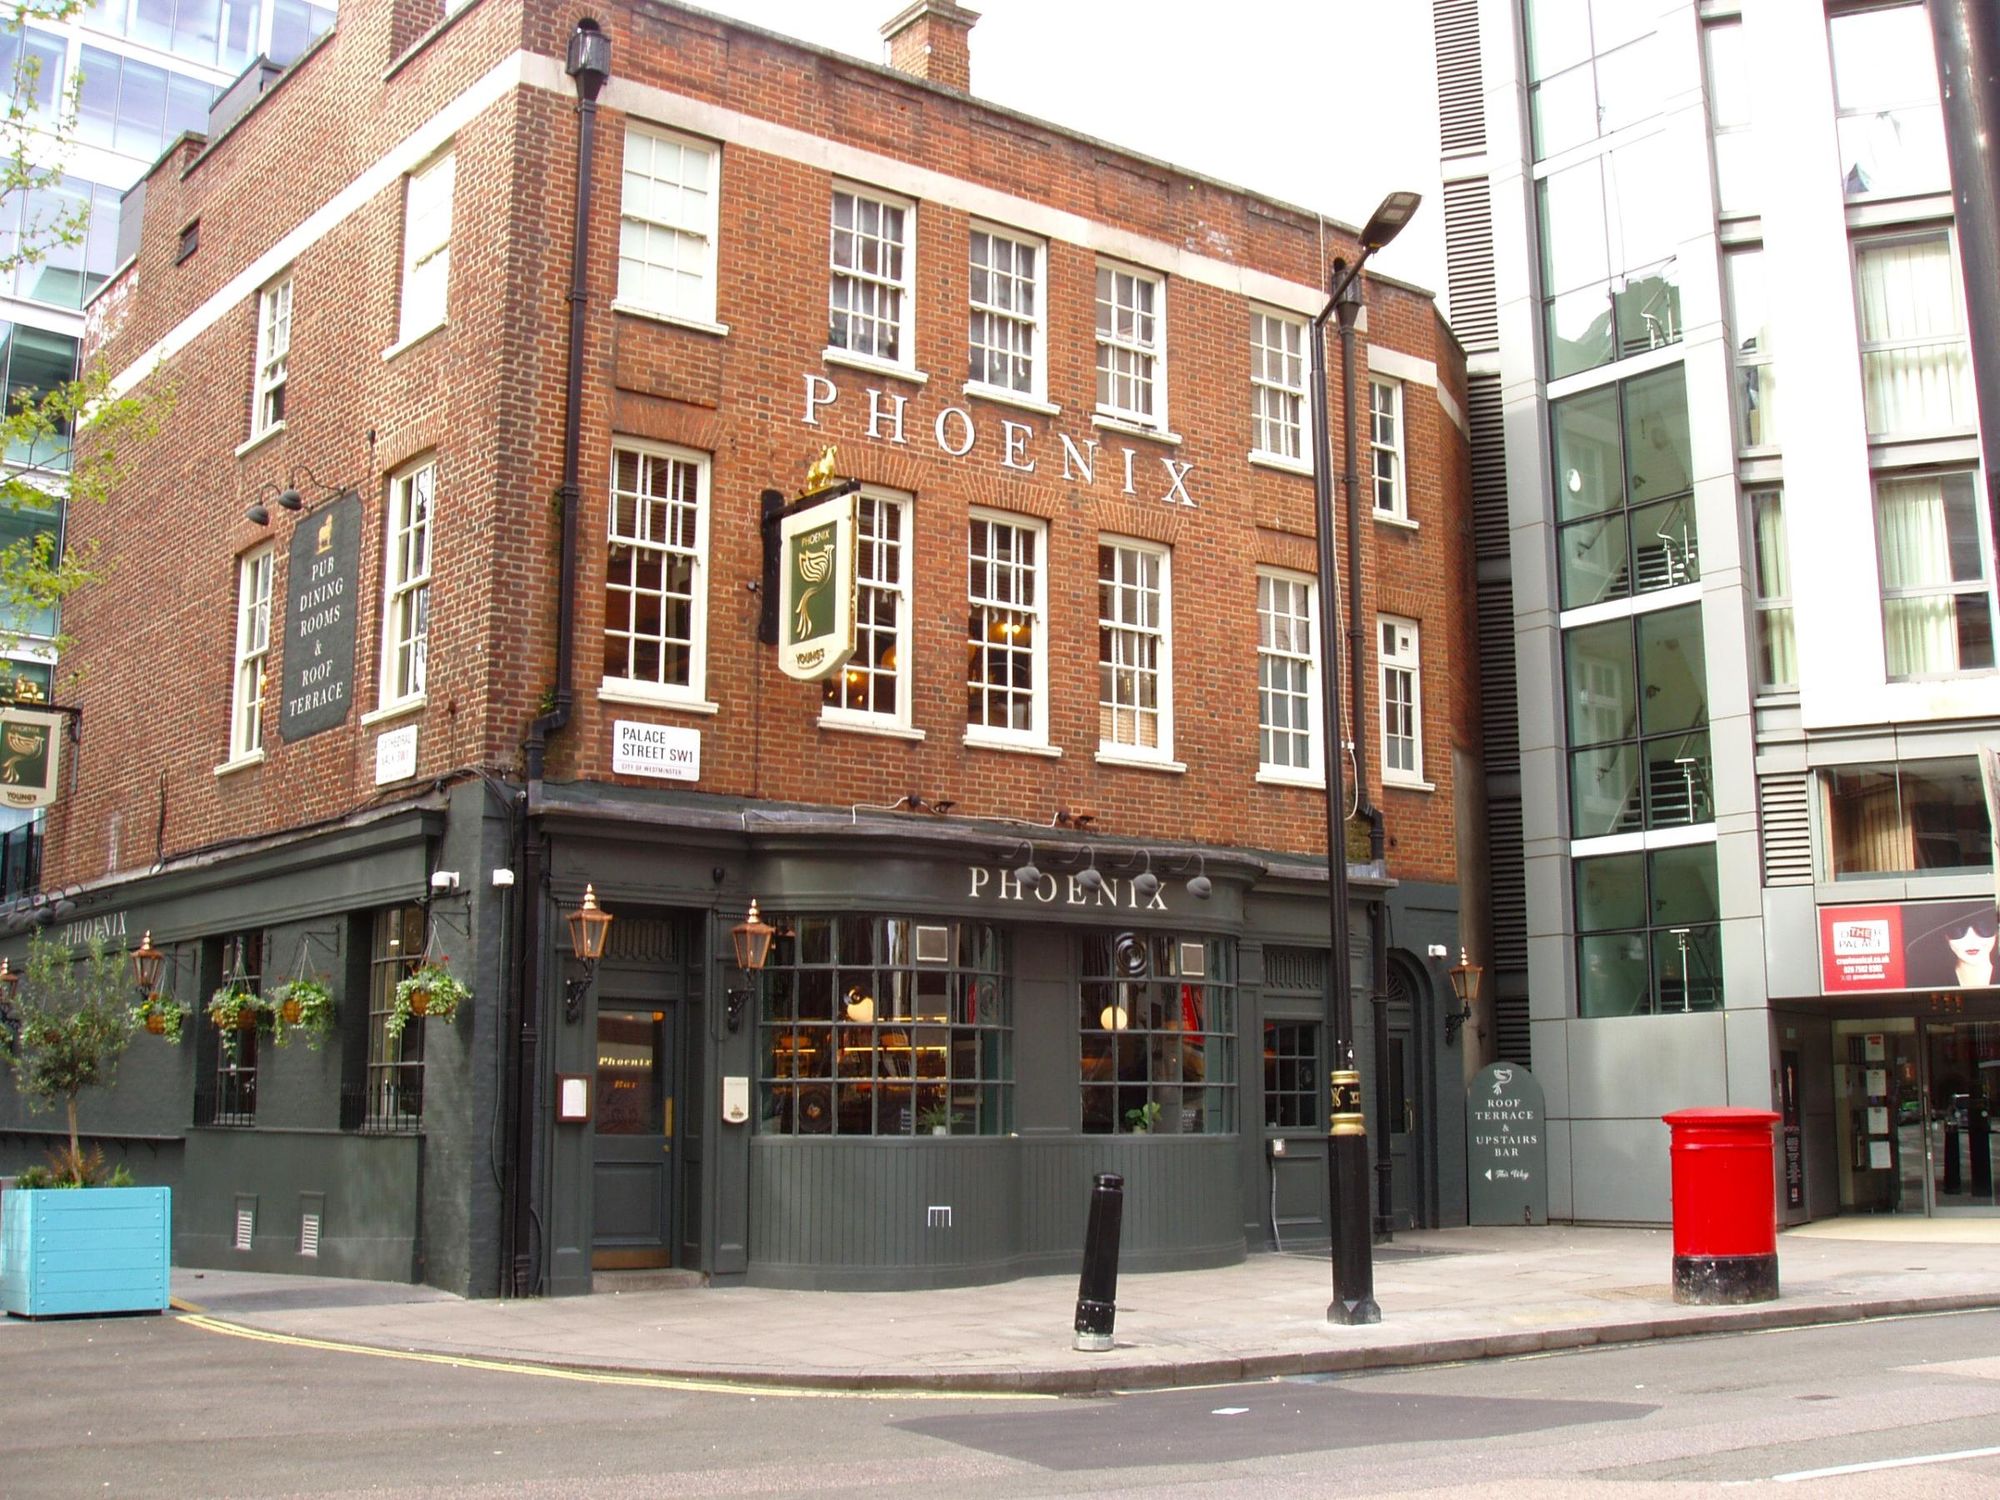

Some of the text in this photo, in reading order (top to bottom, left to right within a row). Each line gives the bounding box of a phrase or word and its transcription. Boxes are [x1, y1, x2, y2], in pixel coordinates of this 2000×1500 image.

[801, 373, 1198, 508] PHOENIX
[801, 529, 830, 547] PHOENIX
[312, 556, 334, 581] PUB
[300, 577, 344, 612] DINING
[300, 605, 341, 637] ROOMS
[314, 639, 322, 656] &
[302, 659, 333, 687] ROOF
[289, 681, 344, 717] TERRACE
[622, 727, 666, 744] PALACE
[622, 743, 693, 763] STREET SW1
[644, 766, 682, 776] WESTMINSTER
[969, 866, 1168, 910] PHOENIX
[599, 1056, 652, 1067] Phoenix
[614, 1080, 638, 1089] Bar
[1488, 1099, 1521, 1108] ROOF
[1475, 1111, 1534, 1120] TERRACE
[1502, 1124, 1510, 1132] &
[1476, 1135, 1537, 1145] UPSTAIRS
[1494, 1148, 1519, 1157] BAR
[1495, 1168, 1530, 1181] This Way
